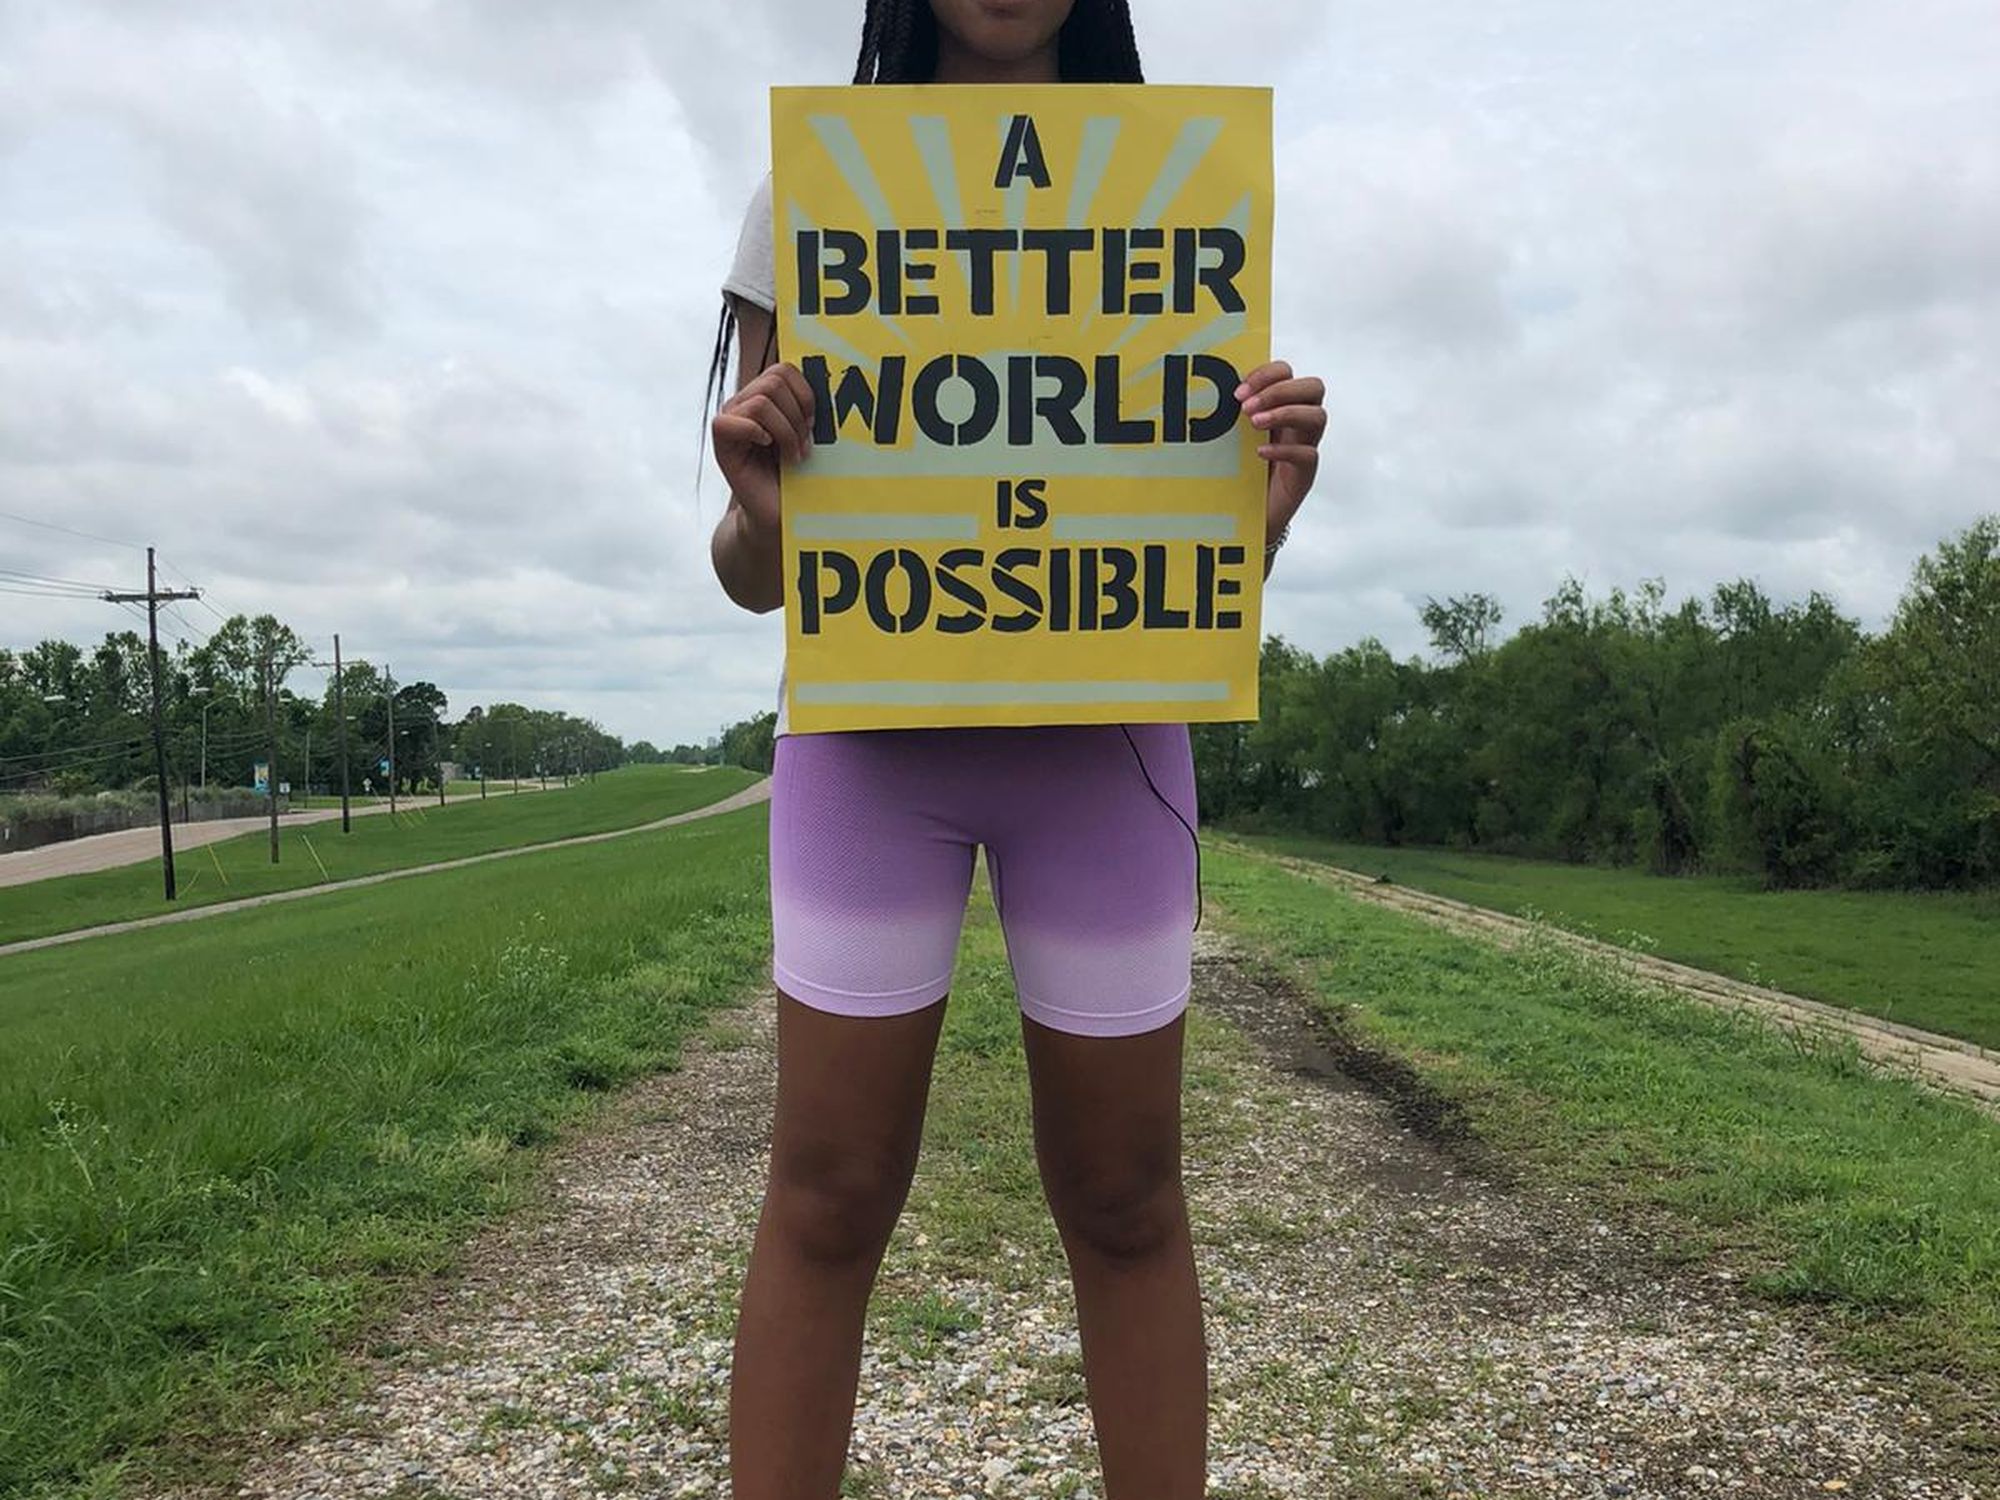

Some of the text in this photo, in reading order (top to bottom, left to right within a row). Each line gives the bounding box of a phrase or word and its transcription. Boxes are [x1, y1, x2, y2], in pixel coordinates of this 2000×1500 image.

[994, 114, 1052, 189] A
[796, 227, 1246, 316] BETTER
[801, 353, 1243, 447] WORLD
[996, 479, 1049, 530] IS
[797, 544, 1245, 635] POSSIBLE
